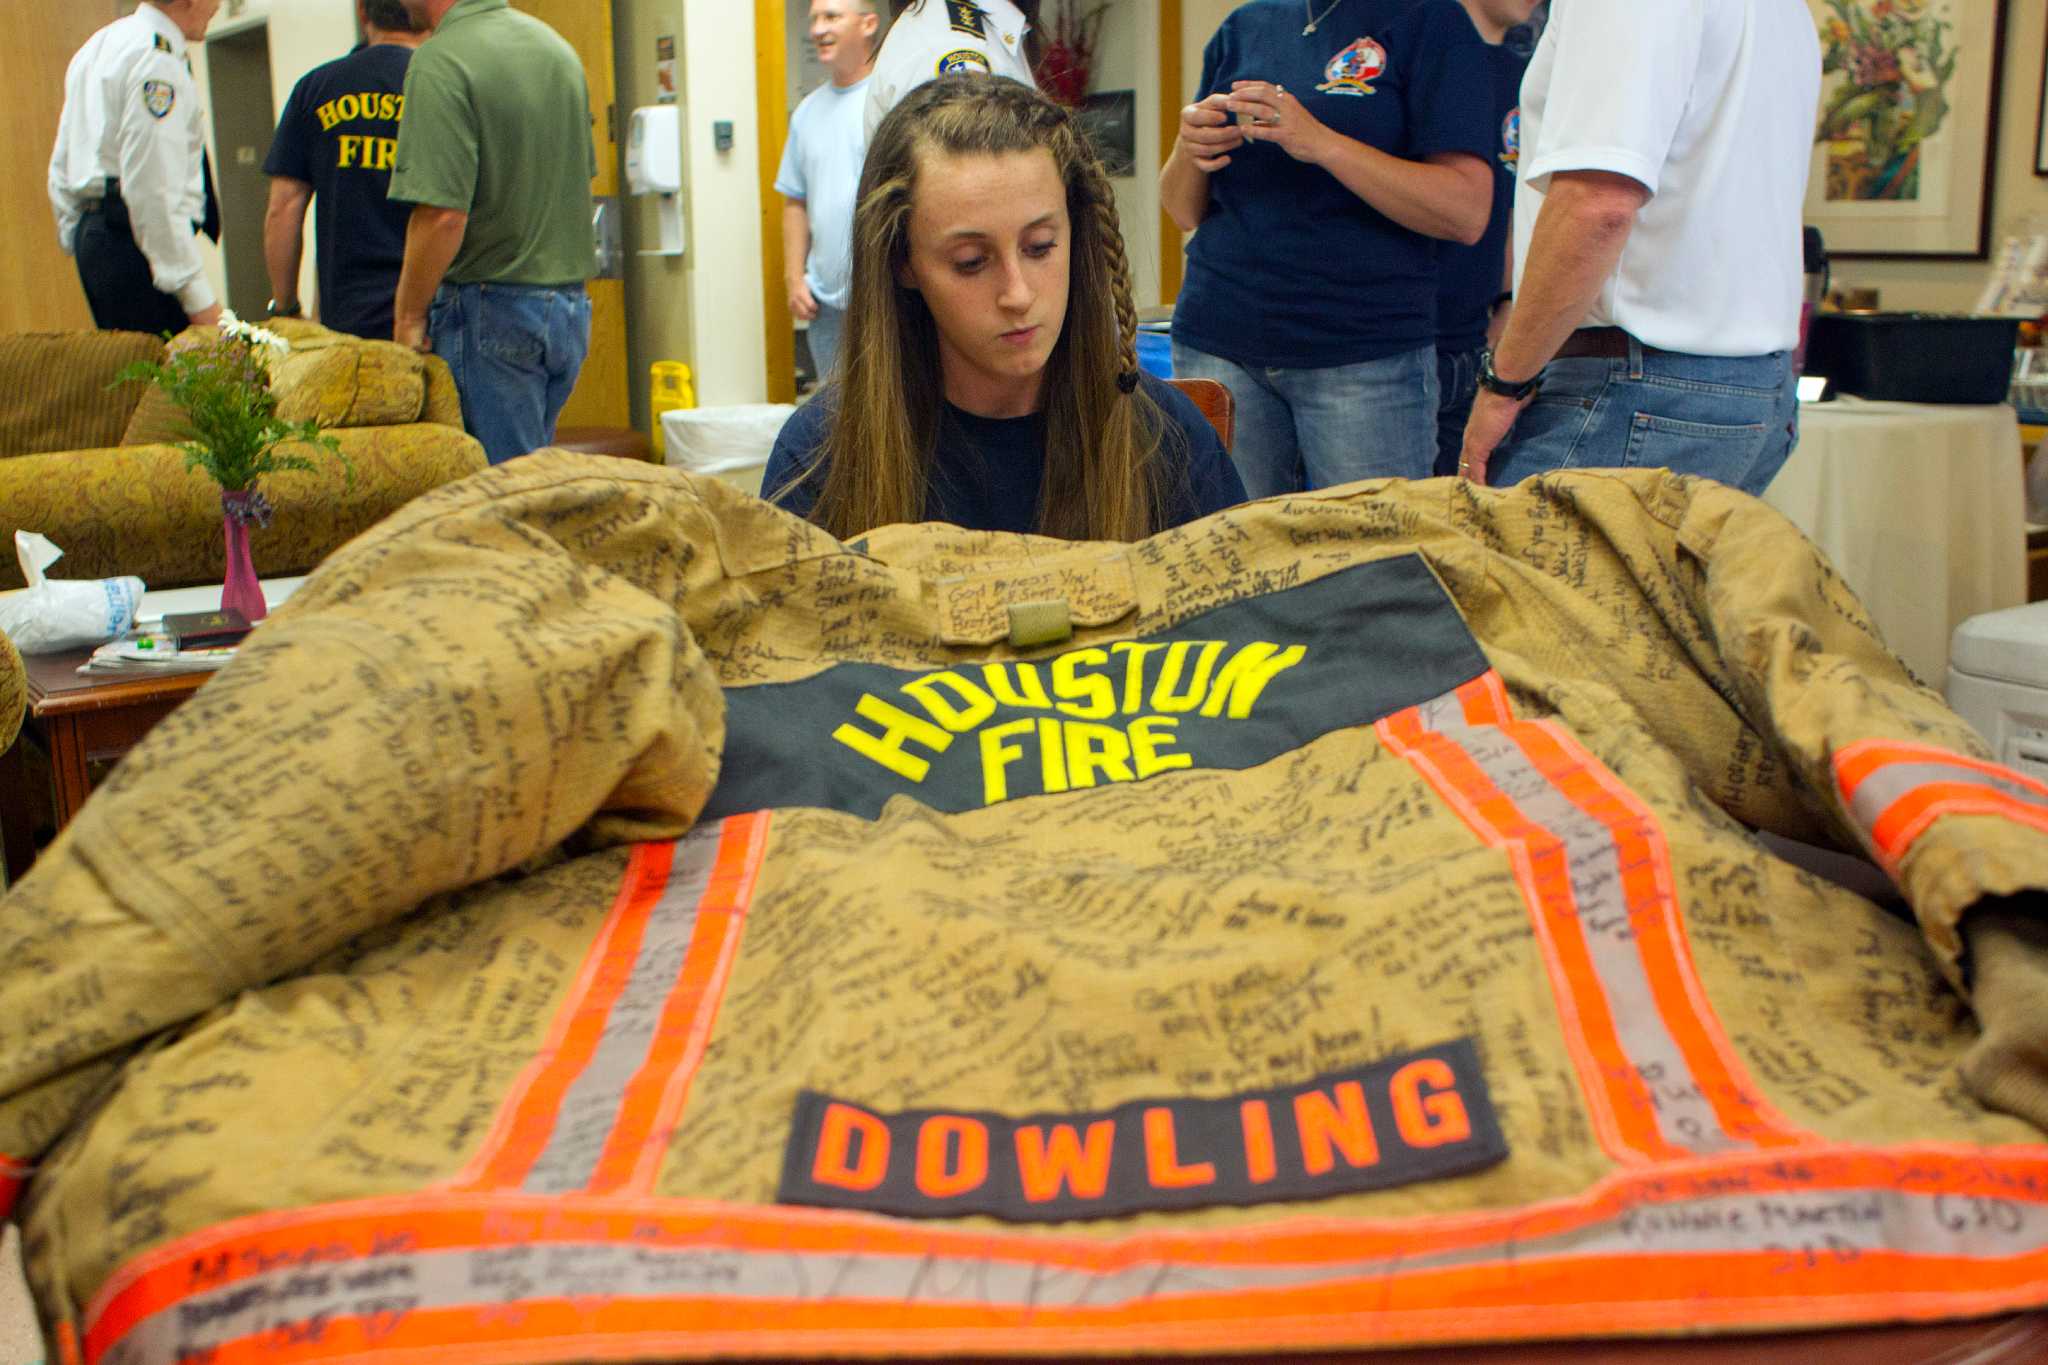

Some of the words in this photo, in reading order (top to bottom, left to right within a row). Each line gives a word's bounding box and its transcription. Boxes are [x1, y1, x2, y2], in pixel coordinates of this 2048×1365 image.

[315, 92, 405, 132] HOUST
[336, 134, 399, 170] FIR
[834, 640, 1306, 783] HOUSTON
[979, 716, 1193, 805] FIRE
[811, 1058, 1471, 1203] DOWLING
